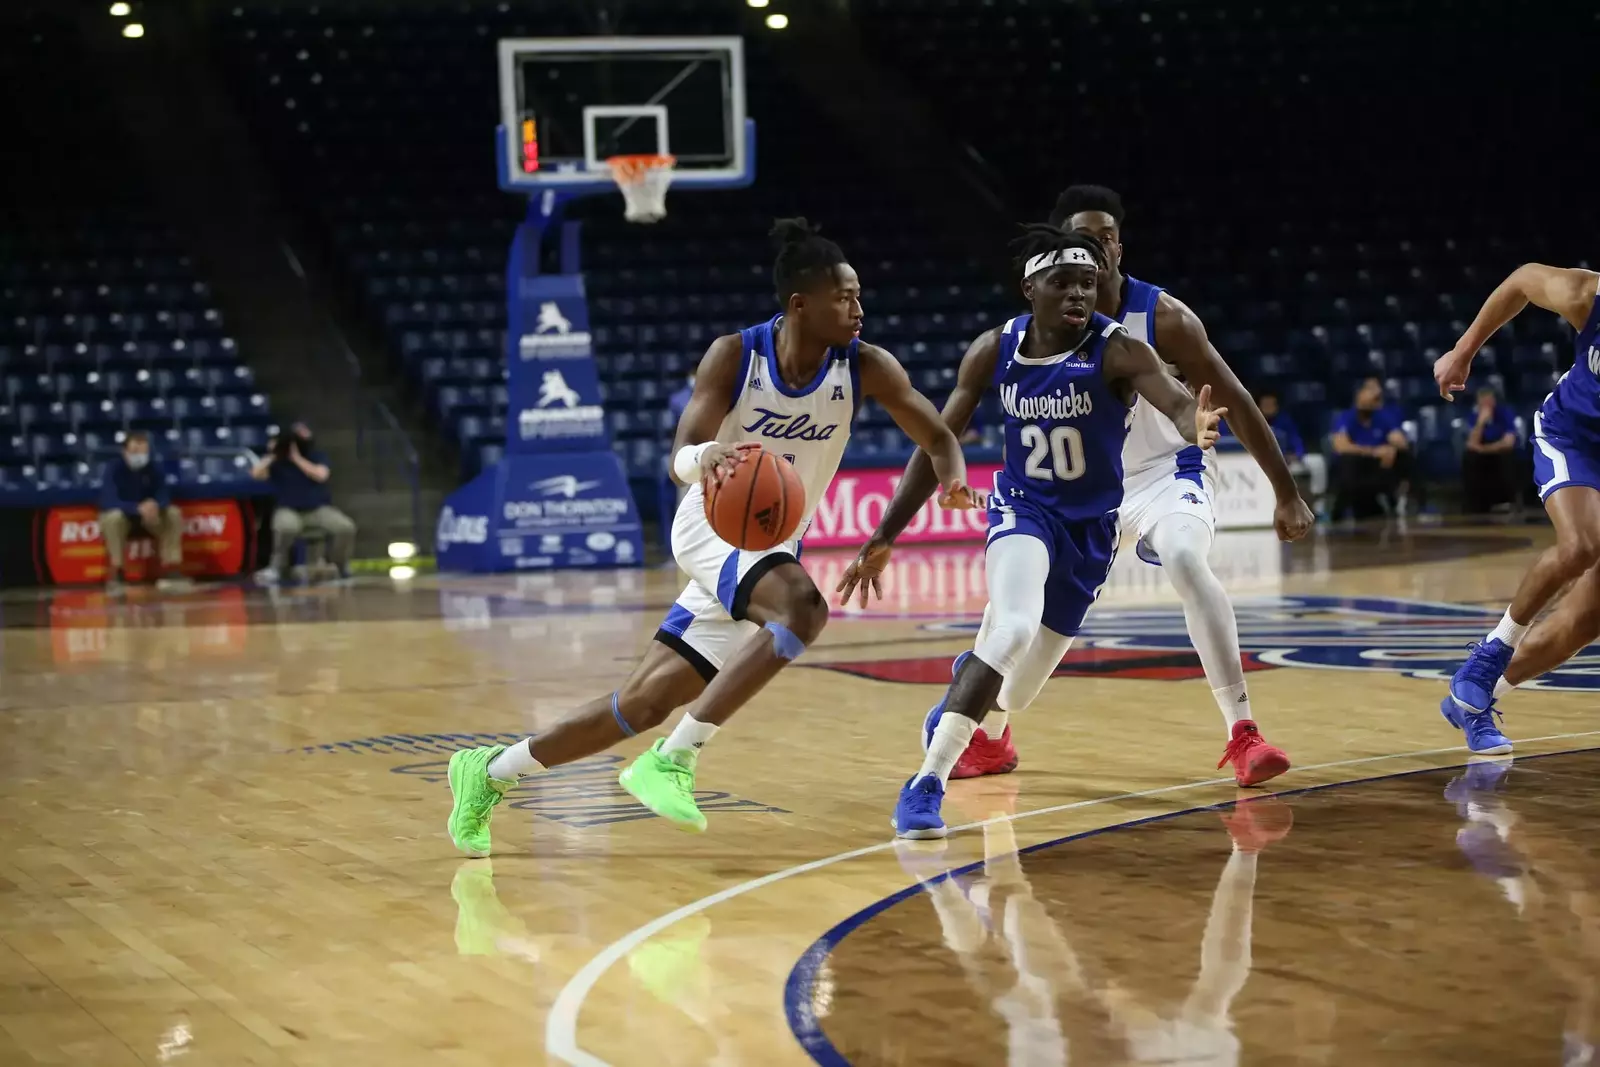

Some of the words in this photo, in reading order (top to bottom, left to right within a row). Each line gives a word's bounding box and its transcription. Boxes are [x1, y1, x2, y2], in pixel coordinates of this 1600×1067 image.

[999, 382, 1093, 420] Mavericks
[742, 407, 839, 441] Tulsa
[1020, 424, 1087, 482] 20
